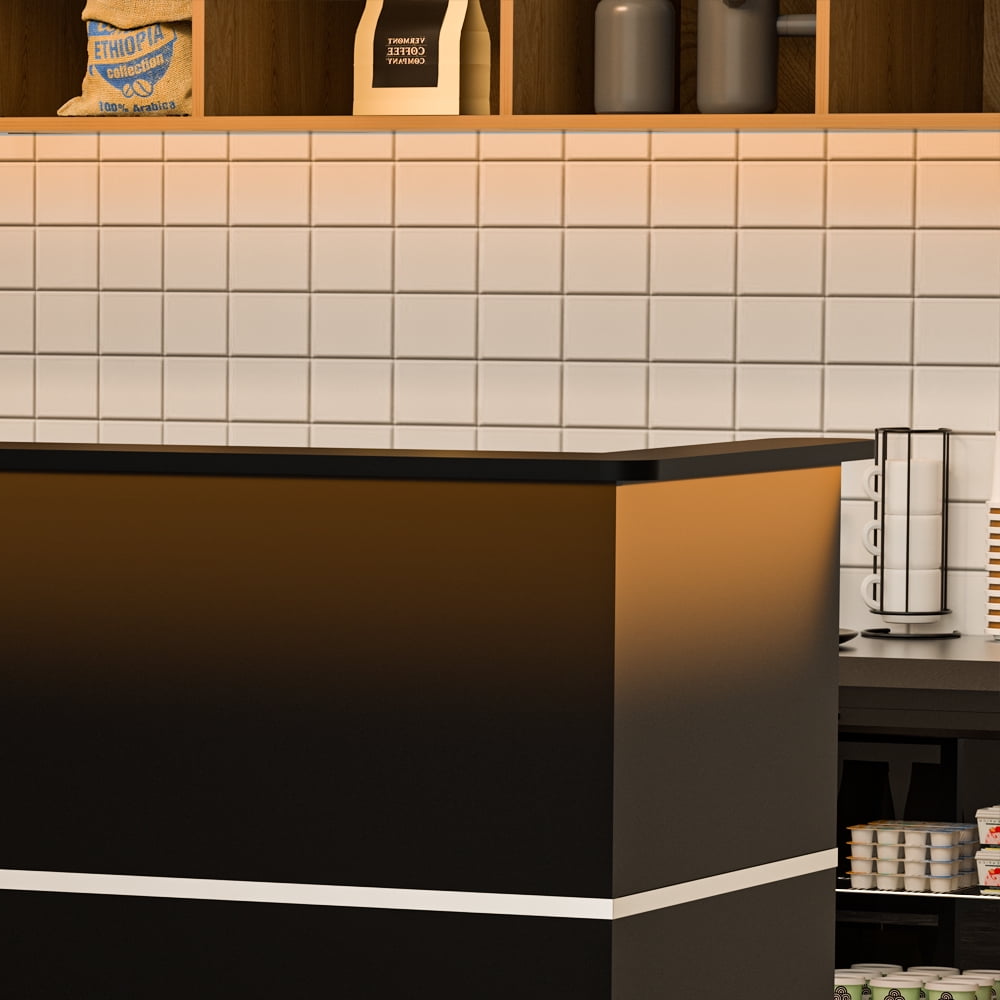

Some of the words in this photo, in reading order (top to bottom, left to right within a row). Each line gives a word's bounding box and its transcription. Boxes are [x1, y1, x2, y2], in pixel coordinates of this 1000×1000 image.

[94, 24, 164, 60] ETHIOPIA
[107, 54, 164, 79] collection
[99, 101, 129, 113] 100%
[133, 101, 176, 113] Arabica
